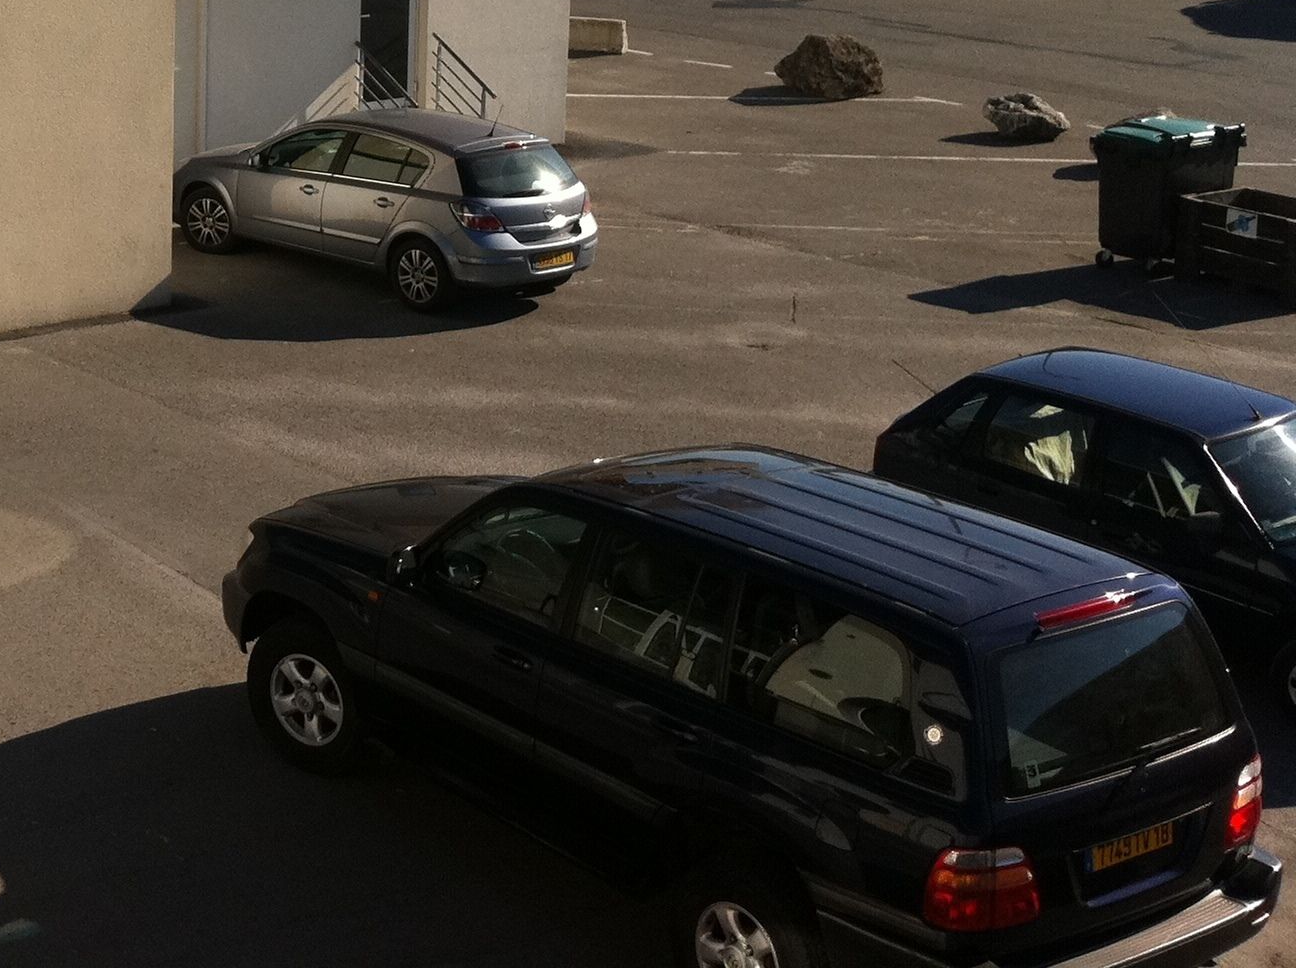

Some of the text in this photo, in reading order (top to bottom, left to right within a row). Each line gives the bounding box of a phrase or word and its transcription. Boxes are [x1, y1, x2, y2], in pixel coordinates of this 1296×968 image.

[1096, 823, 1170, 866] 7749 TV 18
